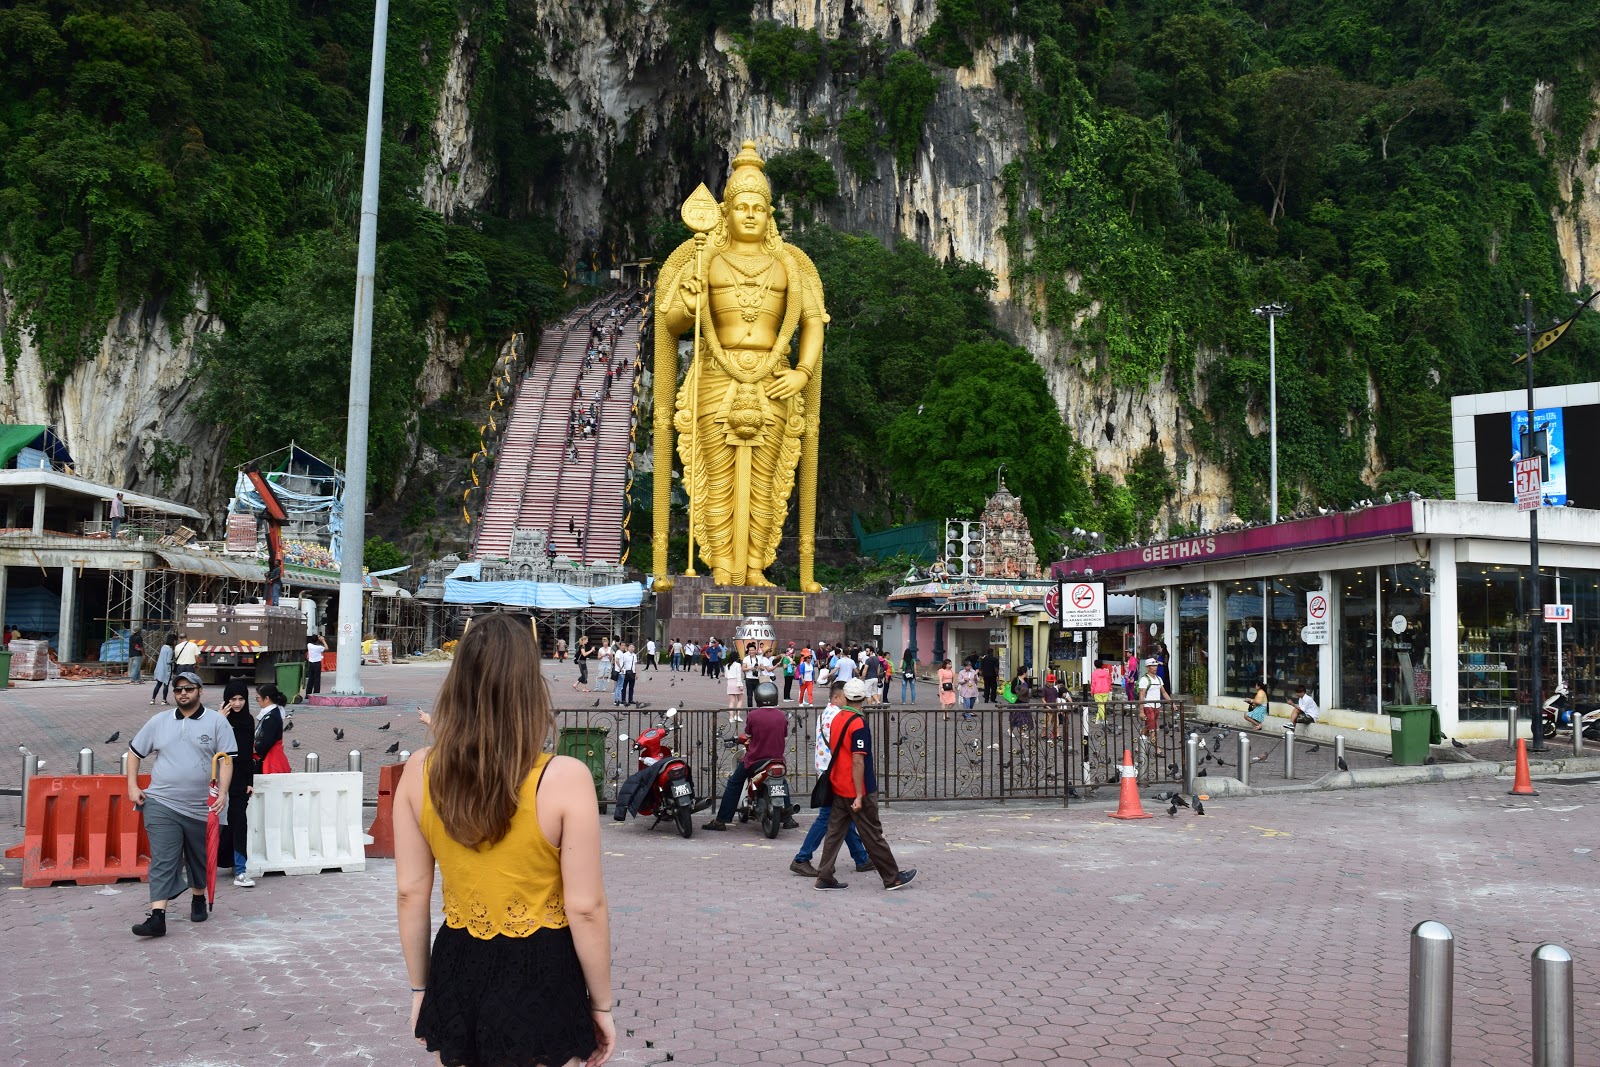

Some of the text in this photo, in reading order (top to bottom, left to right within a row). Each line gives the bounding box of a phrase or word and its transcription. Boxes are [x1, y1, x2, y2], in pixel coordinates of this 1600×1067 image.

[1517, 459, 1539, 473] ZON
[1518, 470, 1540, 493] 3A
[1142, 538, 1216, 562] GEETHA'S
[220, 626, 227, 634] A
[856, 739, 865, 749] 9
